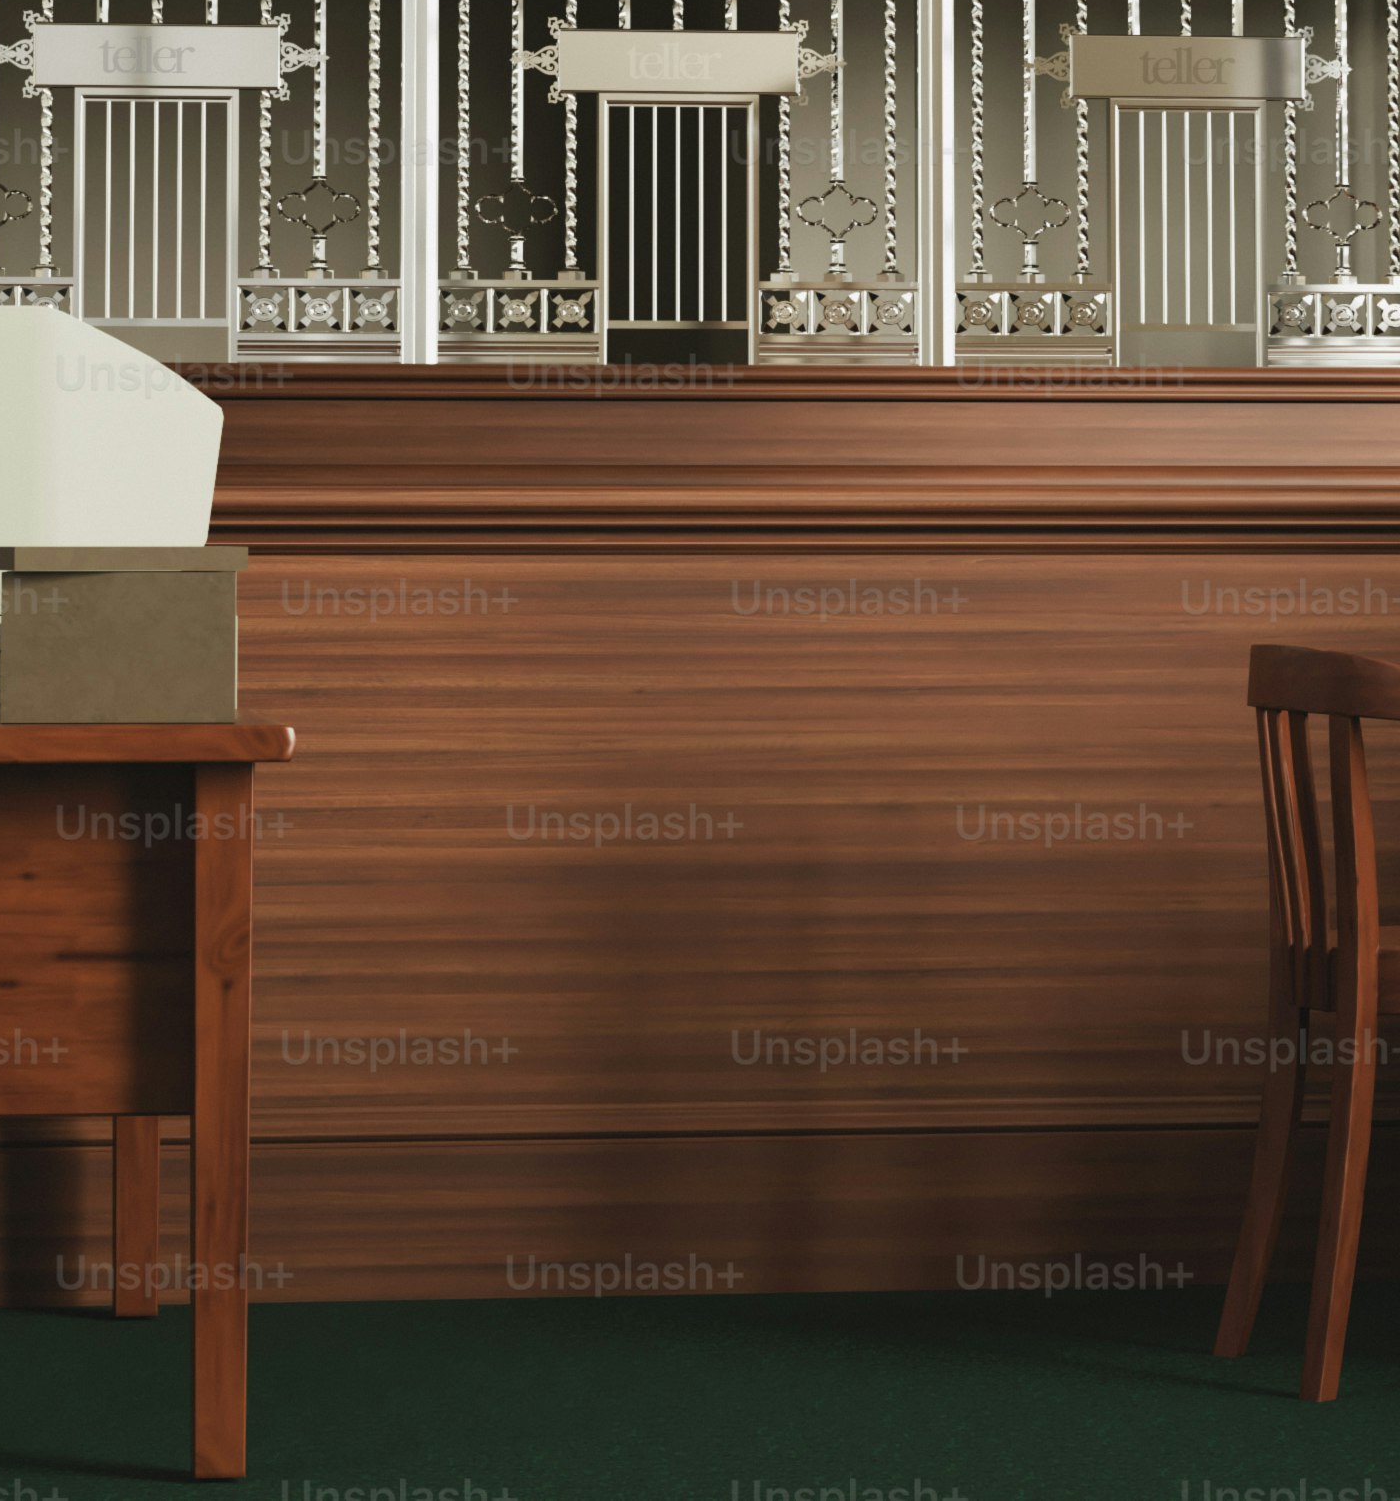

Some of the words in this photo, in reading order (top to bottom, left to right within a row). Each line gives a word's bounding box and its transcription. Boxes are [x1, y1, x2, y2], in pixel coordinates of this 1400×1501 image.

[98, 36, 197, 74] teller
[627, 42, 723, 80] teller
[1138, 47, 1236, 85] teller
